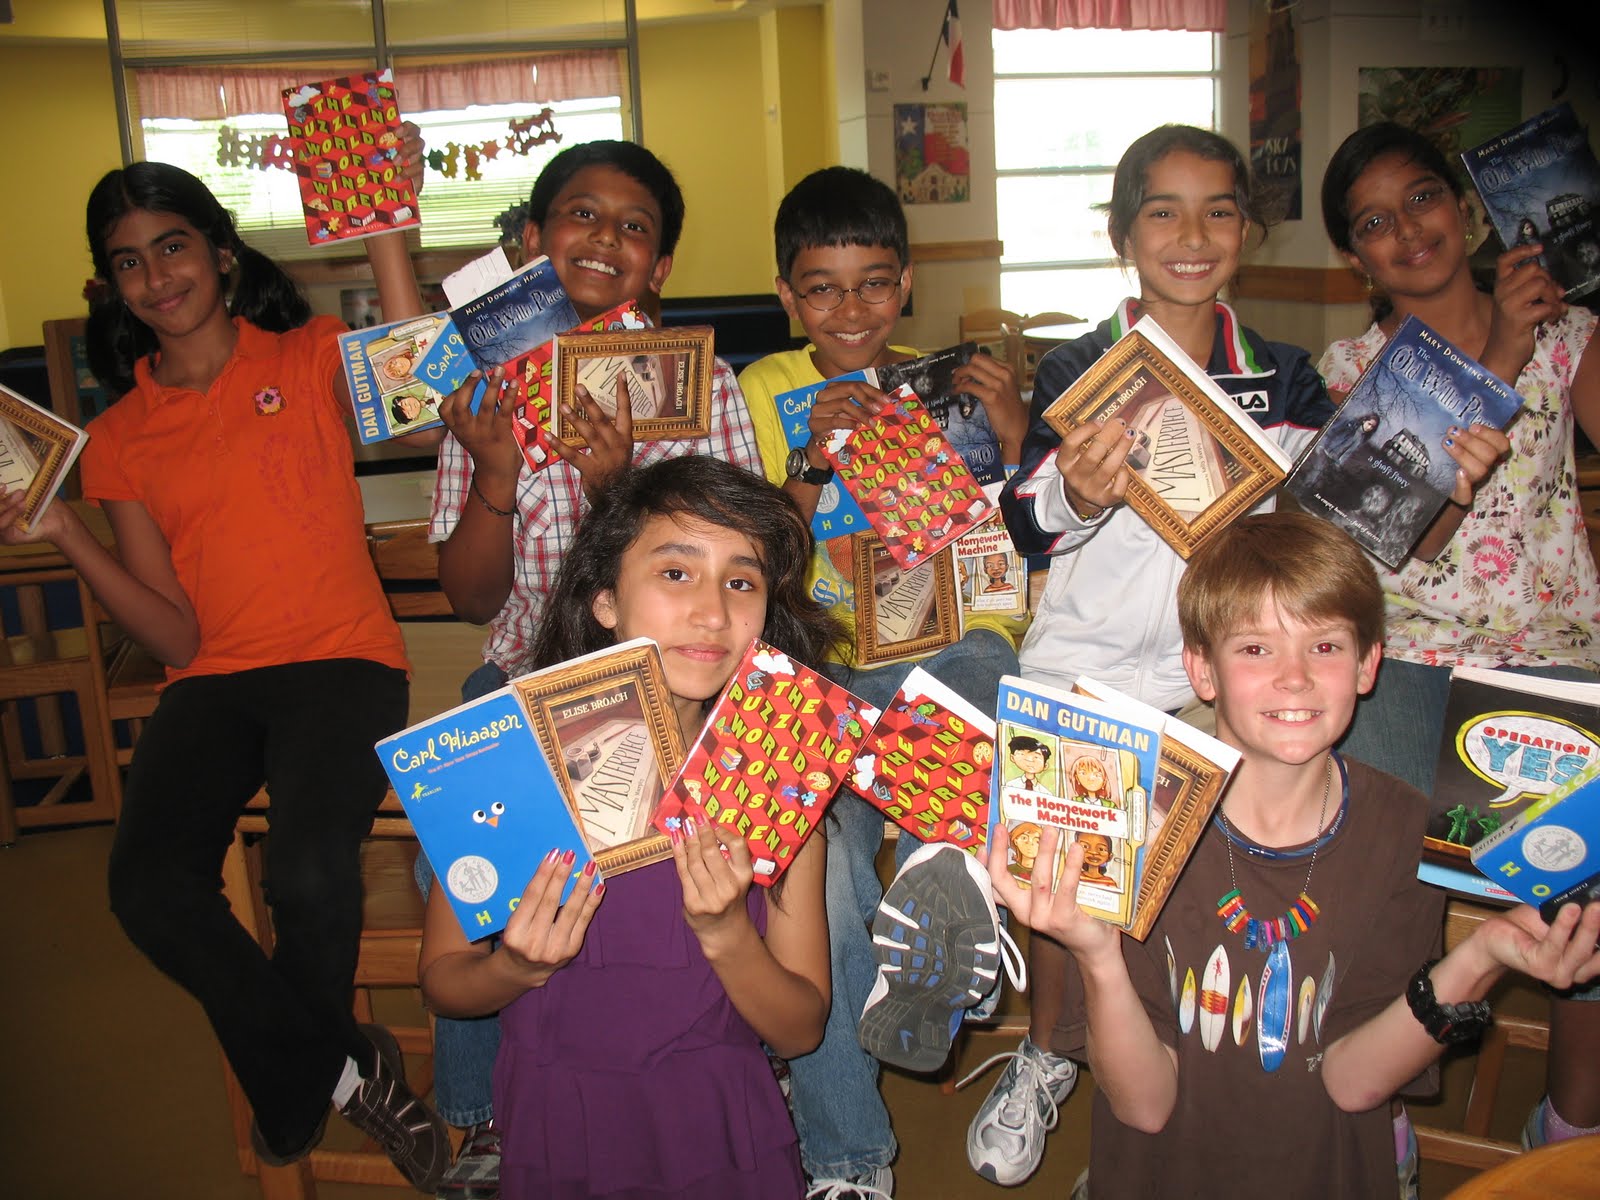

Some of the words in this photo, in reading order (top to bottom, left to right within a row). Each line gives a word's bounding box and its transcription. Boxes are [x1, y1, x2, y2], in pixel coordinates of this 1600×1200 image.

[314, 94, 352, 113] THE
[291, 106, 397, 137] PUZZLING
[305, 131, 374, 156] WORLD
[1477, 144, 1500, 159] MARY
[339, 153, 364, 170] OF
[1479, 167, 1512, 193] Old
[332, 187, 399, 212] BREEN
[465, 301, 486, 317] MARY
[487, 281, 522, 304] DOWNING
[523, 269, 544, 284] HAHN
[468, 322, 498, 347] Old
[494, 303, 535, 331] Willis
[530, 288, 566, 314] Place
[476, 312, 489, 324] The
[427, 344, 459, 380] Carl
[1416, 346, 1431, 361] The
[1419, 329, 1442, 350] MARY
[1443, 346, 1483, 381] DOWNING
[1485, 377, 1510, 398] HAHN
[346, 339, 373, 403] GUTMAN
[1388, 344, 1421, 381] Old
[1421, 364, 1461, 412] Willis
[783, 393, 812, 415] Carl
[1097, 401, 1120, 423] ELISE
[1118, 375, 1148, 405] BROACH
[360, 407, 380, 438] DAN
[852, 420, 886, 450] THE
[840, 414, 931, 481] PUZZLING
[968, 444, 995, 465] Old
[1150, 404, 1201, 502] MASTERPIECE
[859, 447, 922, 489] WORLD
[897, 471, 923, 492] OF
[976, 473, 992, 482] MAR
[881, 464, 968, 523] WINSTON
[905, 489, 969, 532] BREEN
[956, 531, 1009, 547] Homework
[957, 543, 999, 556] Machine
[876, 566, 933, 636] MASTERPIECE
[562, 703, 590, 720] ELISE
[591, 691, 629, 711] BROACH
[774, 681, 822, 714] THE
[728, 682, 852, 765] PUZZLING
[1006, 691, 1049, 722] DAN
[1057, 708, 1150, 752] GUTMAN
[392, 737, 441, 773] Carl
[439, 714, 523, 754] Hiaasen
[730, 712, 807, 774] WORLD
[881, 735, 914, 779] THE
[1483, 726, 1591, 757] OPERATION
[747, 760, 779, 785] OF
[884, 716, 966, 820] PUZZLING
[1481, 735, 1588, 786] YES
[421, 786, 443, 797] YEARLING
[579, 731, 648, 836] MASTERPIECE
[703, 759, 811, 838] WINSTON
[914, 760, 976, 825] WORLD
[961, 791, 987, 819] OF
[1008, 793, 1032, 807] The
[1036, 796, 1118, 823] Homework
[1037, 810, 1099, 831] Machine
[704, 794, 781, 853] BREEN
[1474, 829, 1506, 854] YEARLING
